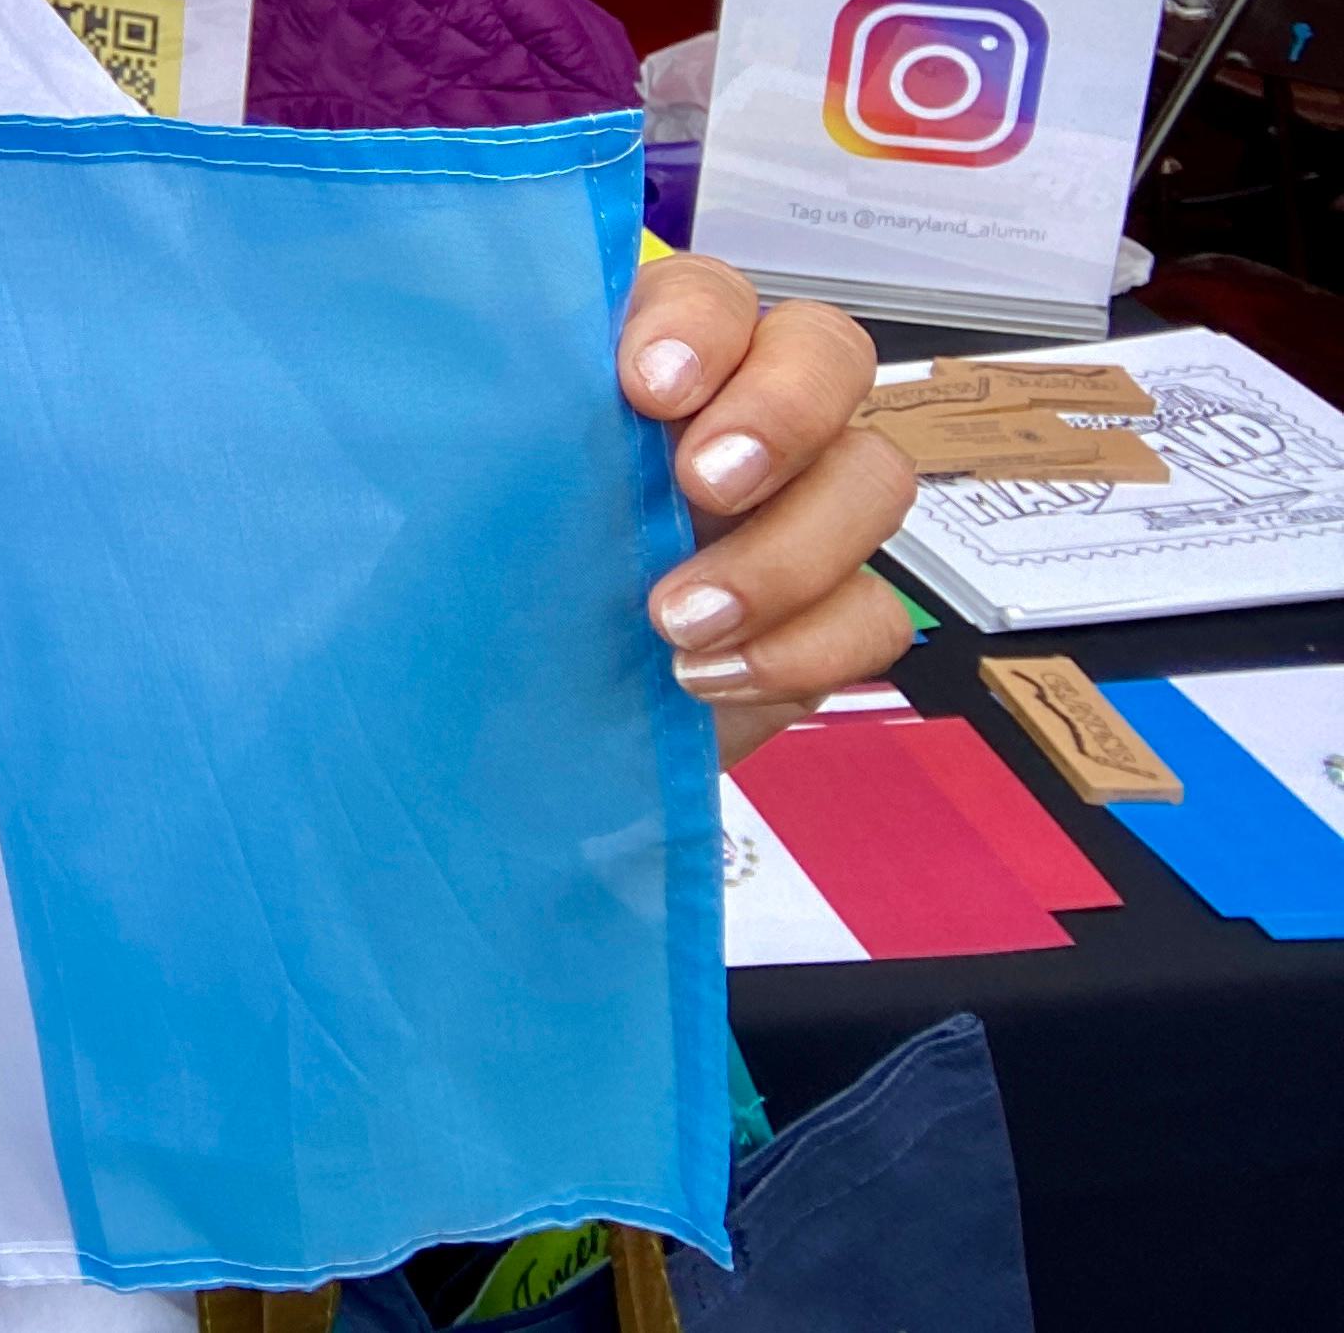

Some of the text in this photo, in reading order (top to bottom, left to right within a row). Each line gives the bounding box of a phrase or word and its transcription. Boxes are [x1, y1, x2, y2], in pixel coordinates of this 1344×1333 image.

[789, 202, 1047, 243] Tag us @maryland_alumni
